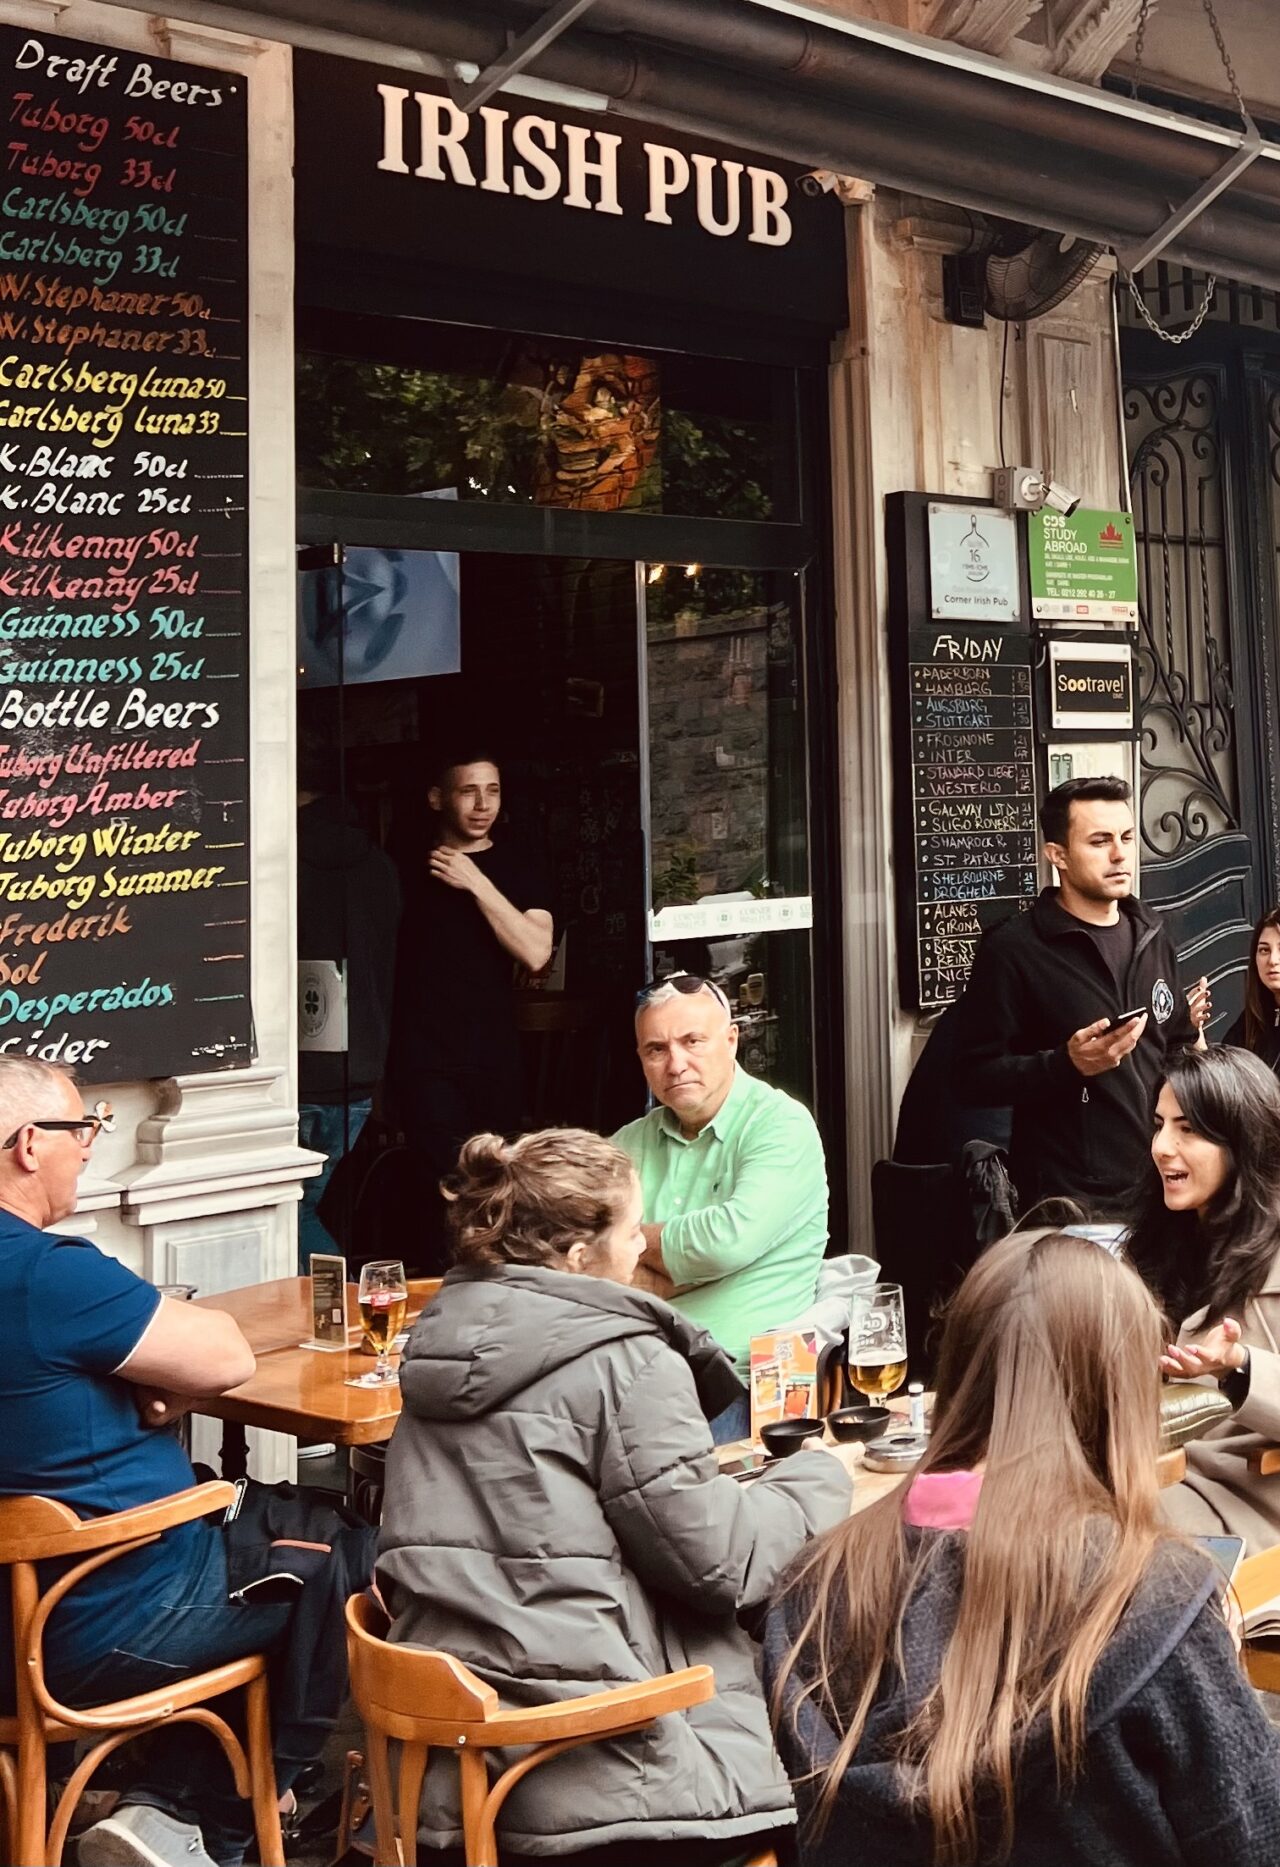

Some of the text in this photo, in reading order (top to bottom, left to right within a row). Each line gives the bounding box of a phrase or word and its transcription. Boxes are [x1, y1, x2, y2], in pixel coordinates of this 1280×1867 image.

[15, 39, 223, 107] Draft Beers
[9, 93, 181, 151] Tuborg 50cl
[7, 142, 176, 197] Tuborg 33cl
[376, 83, 792, 247] IRISH PUB
[1, 187, 188, 245] Carlsberg 50cl
[0, 231, 181, 286] Carlsberg 33cl
[0, 356, 138, 412] Carlsberg
[0, 398, 124, 448] Carlsberg
[133, 451, 188, 480] 50cl
[137, 488, 192, 514] 25cl
[0, 520, 199, 576] Kilkenny 50cl
[1043, 528, 1078, 540] STUDY
[1044, 541, 1088, 553] ABROAD
[0, 565, 200, 613] Kilkenny 25cl
[944, 594, 1009, 607] Corner Irish Pub
[0, 605, 204, 640] Guinness 50cl
[933, 634, 1003, 662] FRIDAY
[0, 648, 205, 685] Guinness 25cl
[1057, 674, 1125, 693] Sootravel
[0, 686, 221, 730] Bottle Beers
[926, 697, 988, 713] AUGSBURG
[924, 714, 993, 728] STUTTGART
[926, 733, 995, 748] FROSINONE
[64, 739, 202, 783] Unfiltered
[931, 750, 976, 764] INTER
[76, 782, 187, 814] Amber
[929, 800, 983, 817] GALWAY
[932, 818, 972, 832] SLIGO
[974, 815, 1016, 832] ROVERS
[93, 823, 201, 858] Winter
[930, 836, 994, 850] SHAMROCK
[962, 853, 1012, 866] PATRICKS
[0, 866, 225, 910] Tuborg Summer
[932, 870, 1007, 886] SHELBOURNE
[934, 884, 996, 901] DROGHEDA
[0, 902, 133, 947] Frederik
[934, 903, 979, 921] ALAVES
[935, 918, 982, 936] GIRONA
[933, 940, 977, 955] BREST
[0, 951, 48, 985] Sol
[936, 969, 972, 982] NICE
[0, 978, 175, 1028] Desperados
[934, 985, 956, 999] LE
